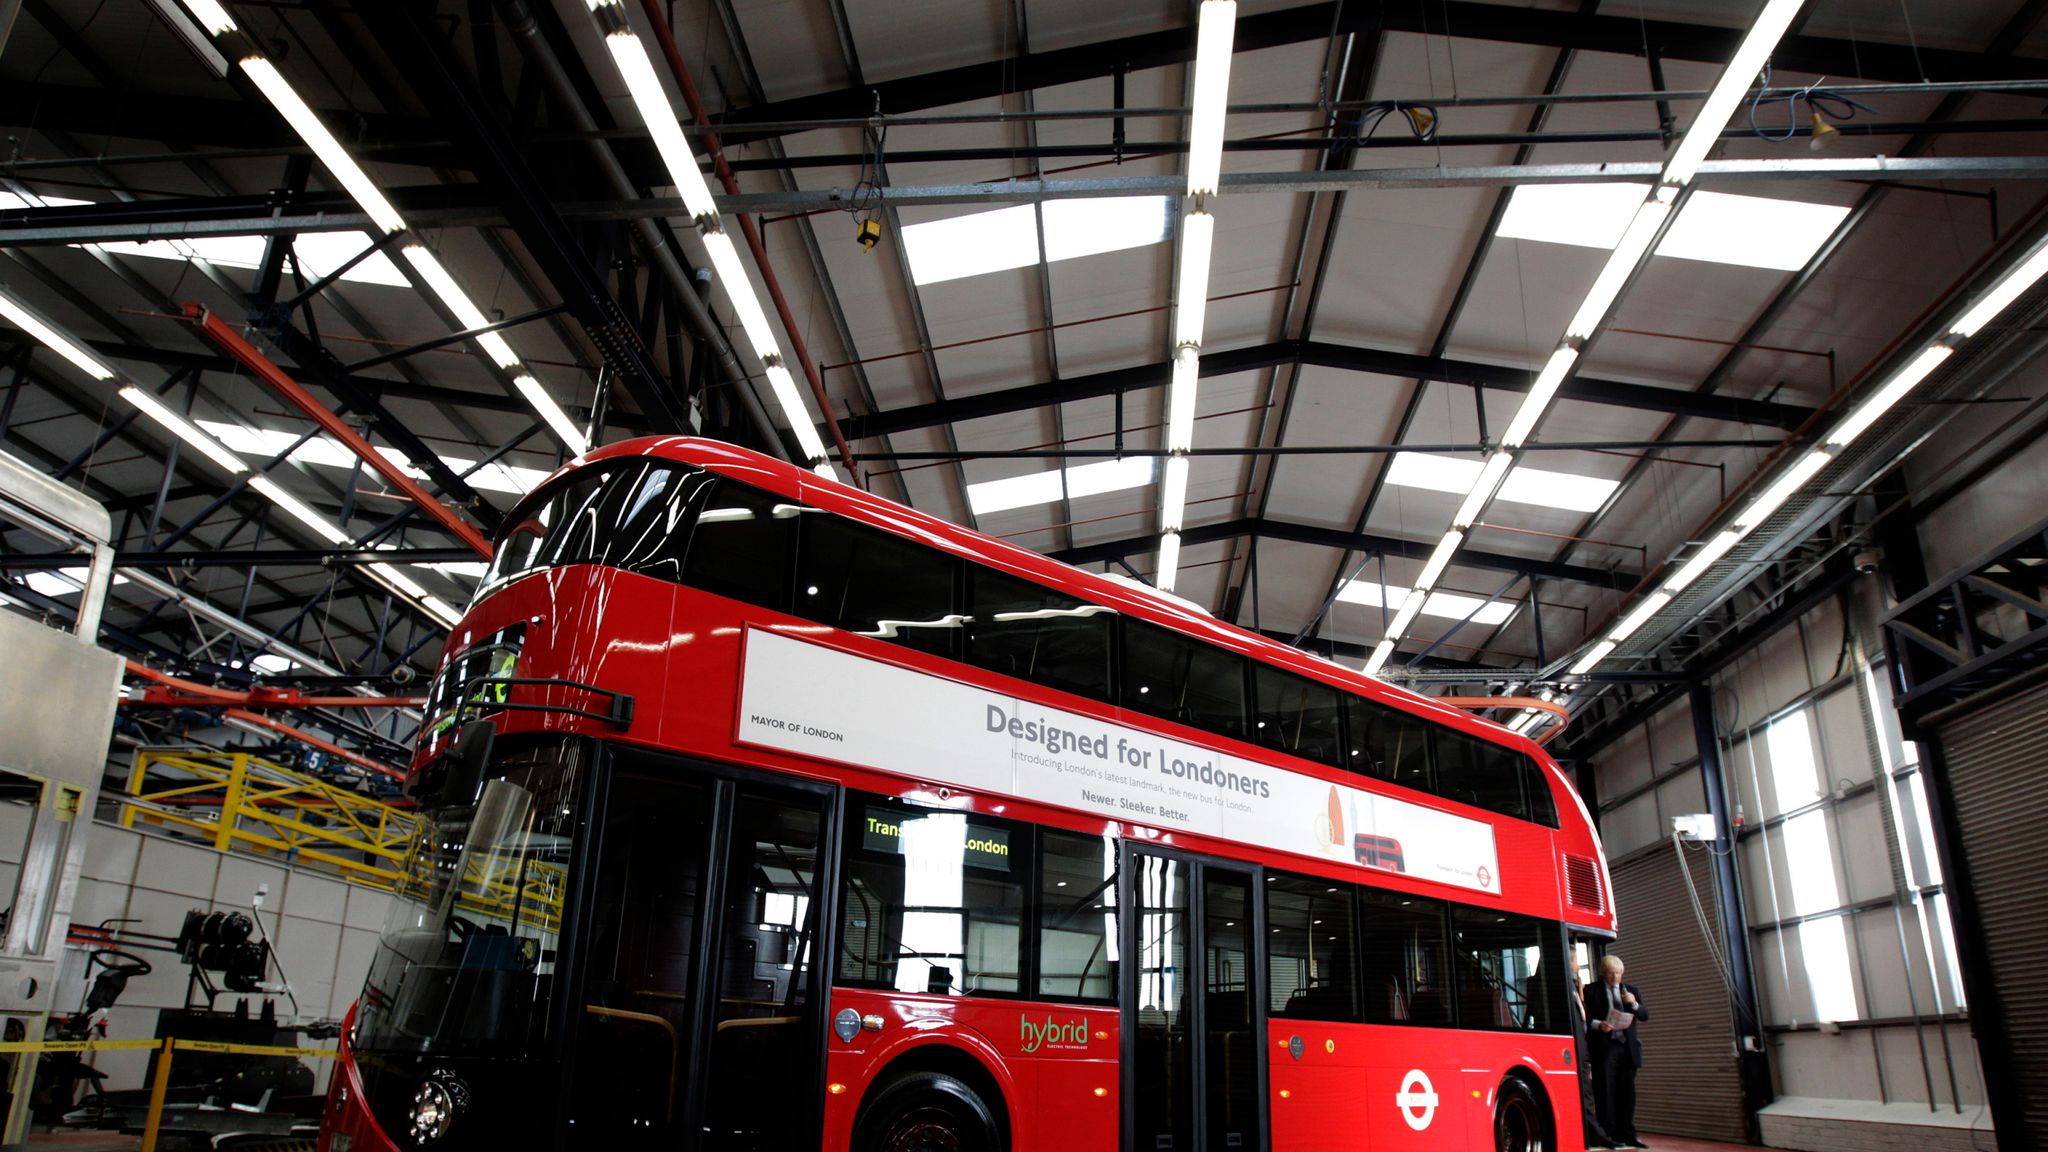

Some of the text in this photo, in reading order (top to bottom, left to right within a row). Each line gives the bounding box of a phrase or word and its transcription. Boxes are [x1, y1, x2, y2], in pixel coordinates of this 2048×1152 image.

[751, 714, 843, 742] MAYOR OF LONDON
[986, 703, 1270, 799] Designed for Londoners
[1011, 748, 1062, 773] Introducing
[1064, 760, 1103, 780] London's
[1104, 770, 1128, 785] latest
[1168, 786, 1182, 798] the
[1183, 791, 1198, 800] new
[1200, 794, 1213, 804] bus
[1214, 796, 1224, 807] for
[1081, 788, 1190, 822] Newer. Sleeker. Better.
[1021, 1013, 1088, 1053] hybrid
